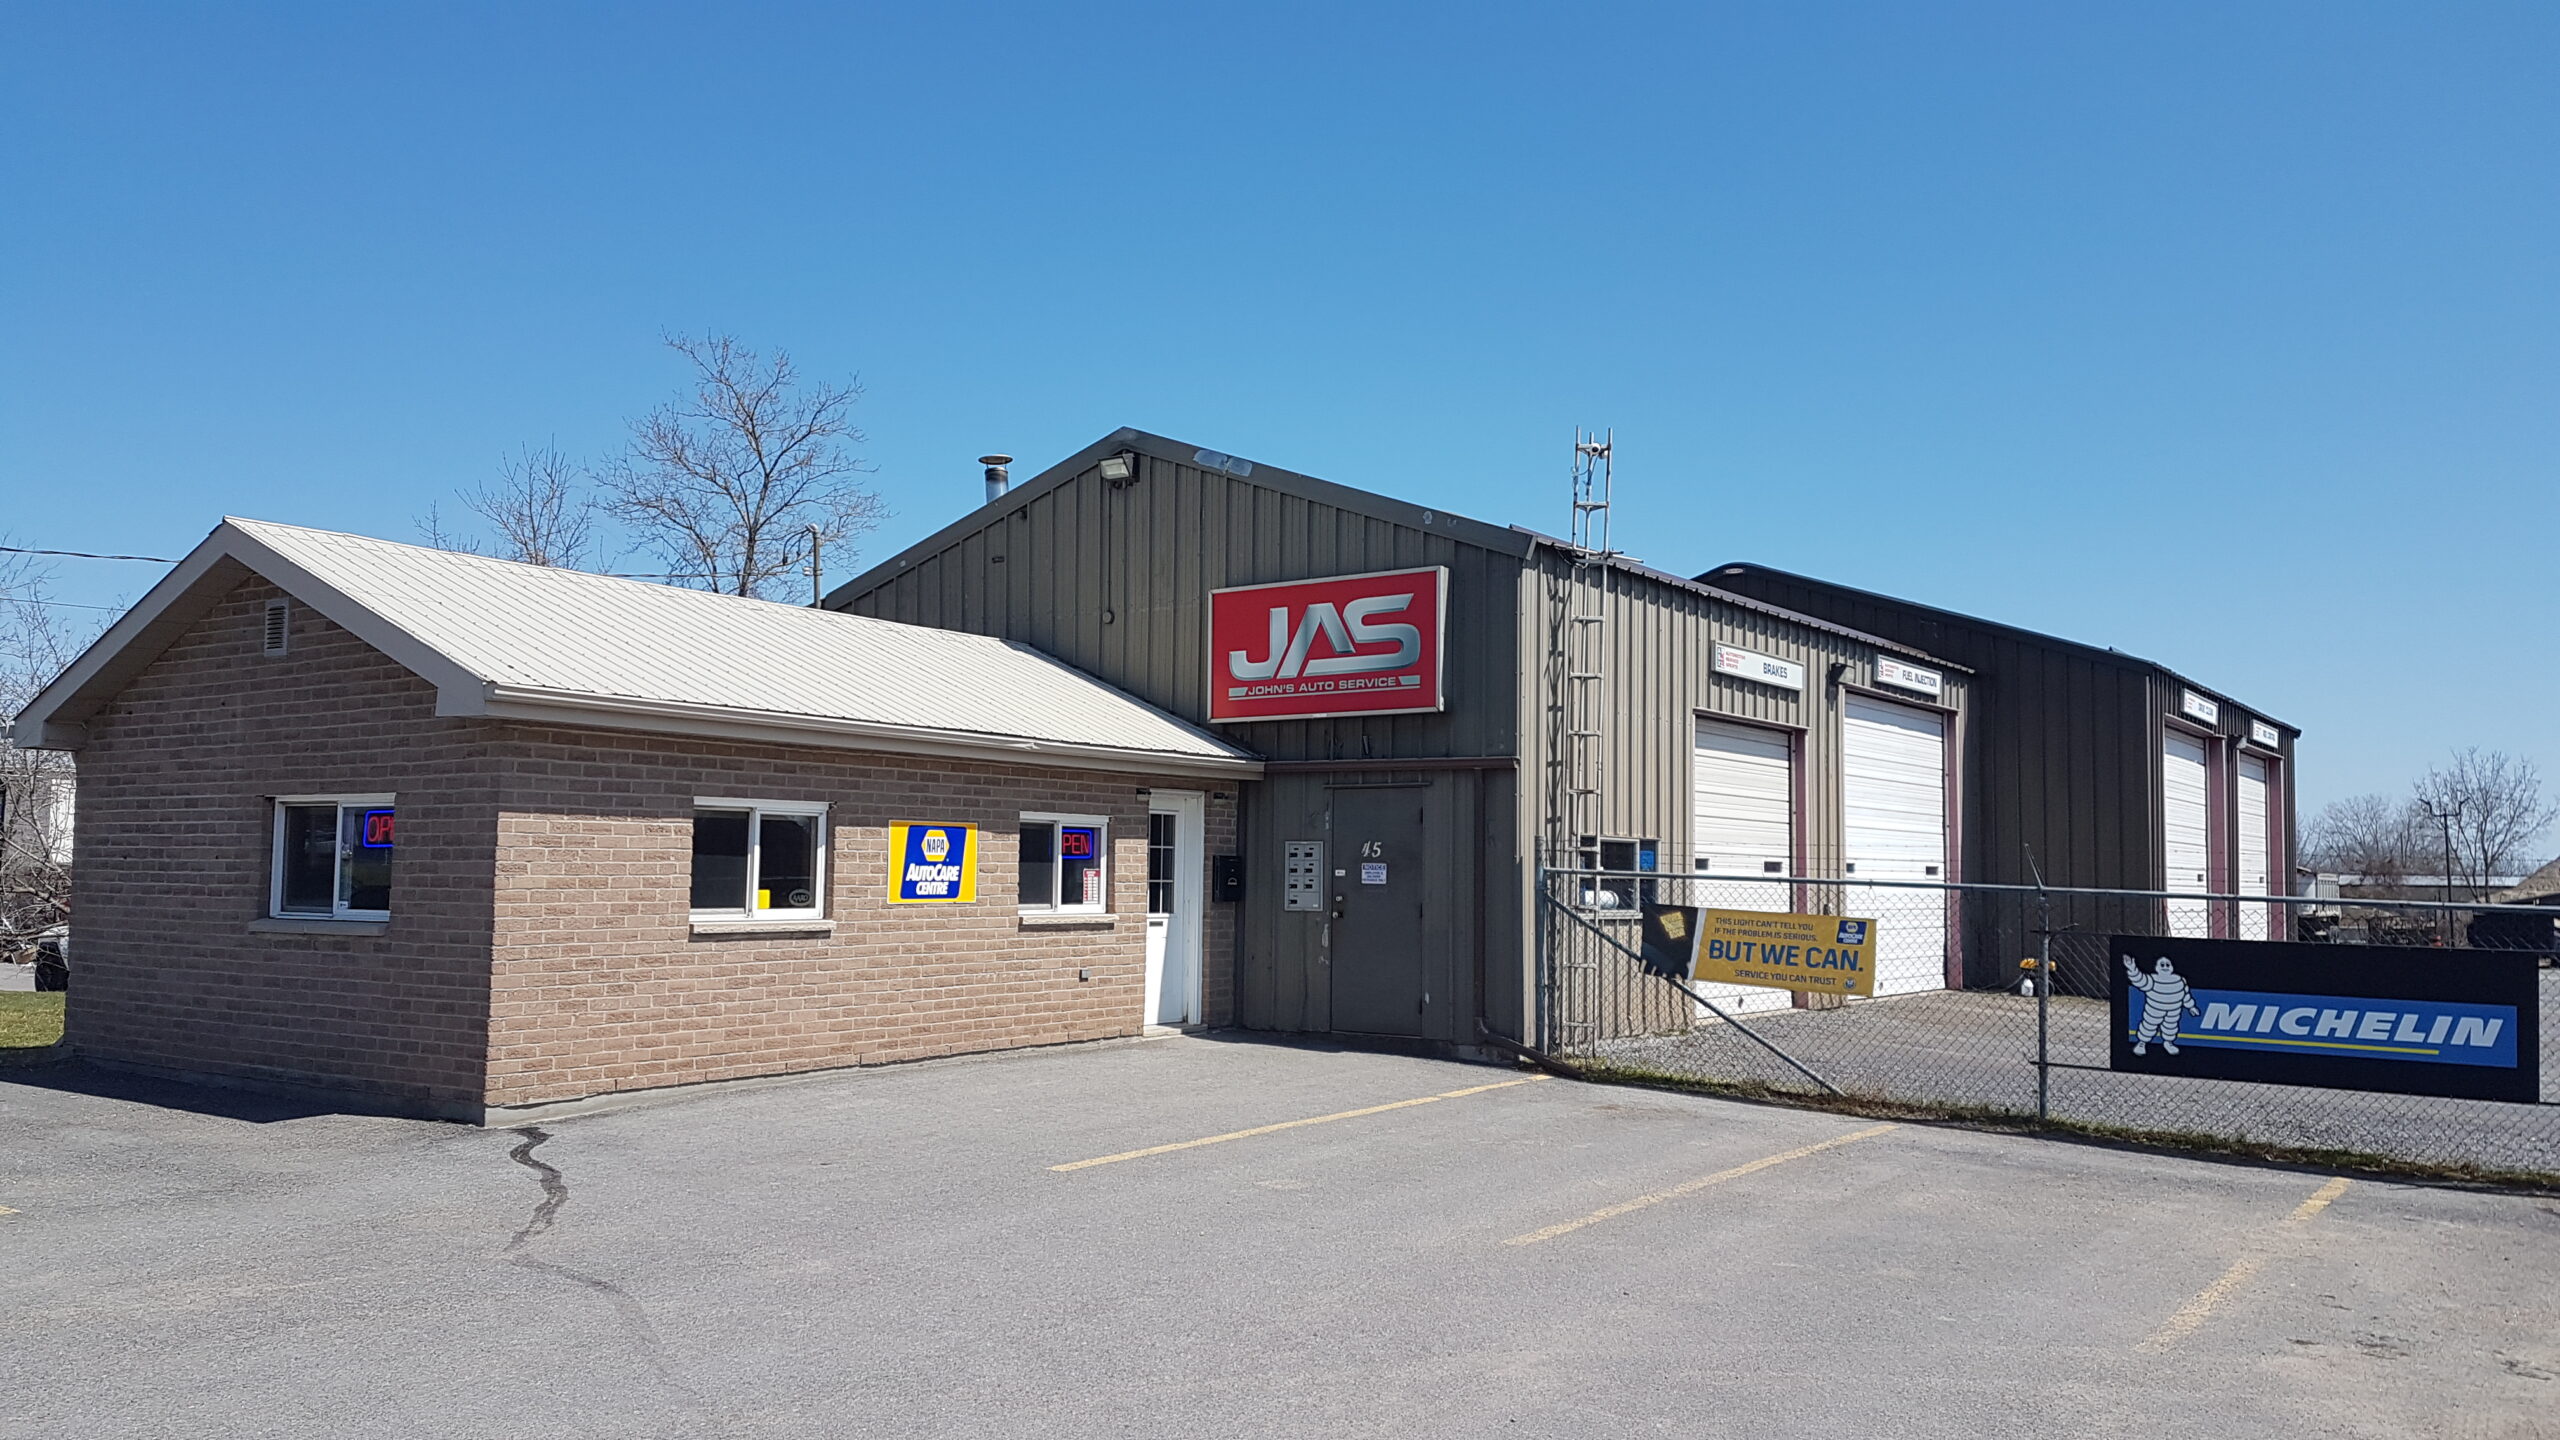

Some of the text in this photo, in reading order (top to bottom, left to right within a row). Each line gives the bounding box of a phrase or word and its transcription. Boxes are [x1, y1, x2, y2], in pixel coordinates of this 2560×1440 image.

[1229, 593, 1421, 681] JAS
[1763, 662, 1788, 679] BRAKES
[1902, 669, 1914, 682] FUEL
[1914, 672, 1938, 688] INJECTION
[1248, 677, 1397, 696] JOHN'S AUTO SERVICE
[367, 815, 395, 842] OP
[926, 838, 945, 853] NAPA
[1062, 834, 1089, 854] PEN
[1361, 841, 1382, 858] 45
[916, 881, 949, 895] CENTRE
[1715, 917, 1814, 931] THIS LIGHT CAN'T TELL YOU
[1738, 929, 1773, 938] PROBLEM
[1774, 931, 1782, 939] IS
[1709, 939, 1864, 972] BUT WE CAN.
[1734, 969, 1837, 986] SERVICE YOU CAN TRUST
[2200, 1003, 2503, 1048] MICHELIN
